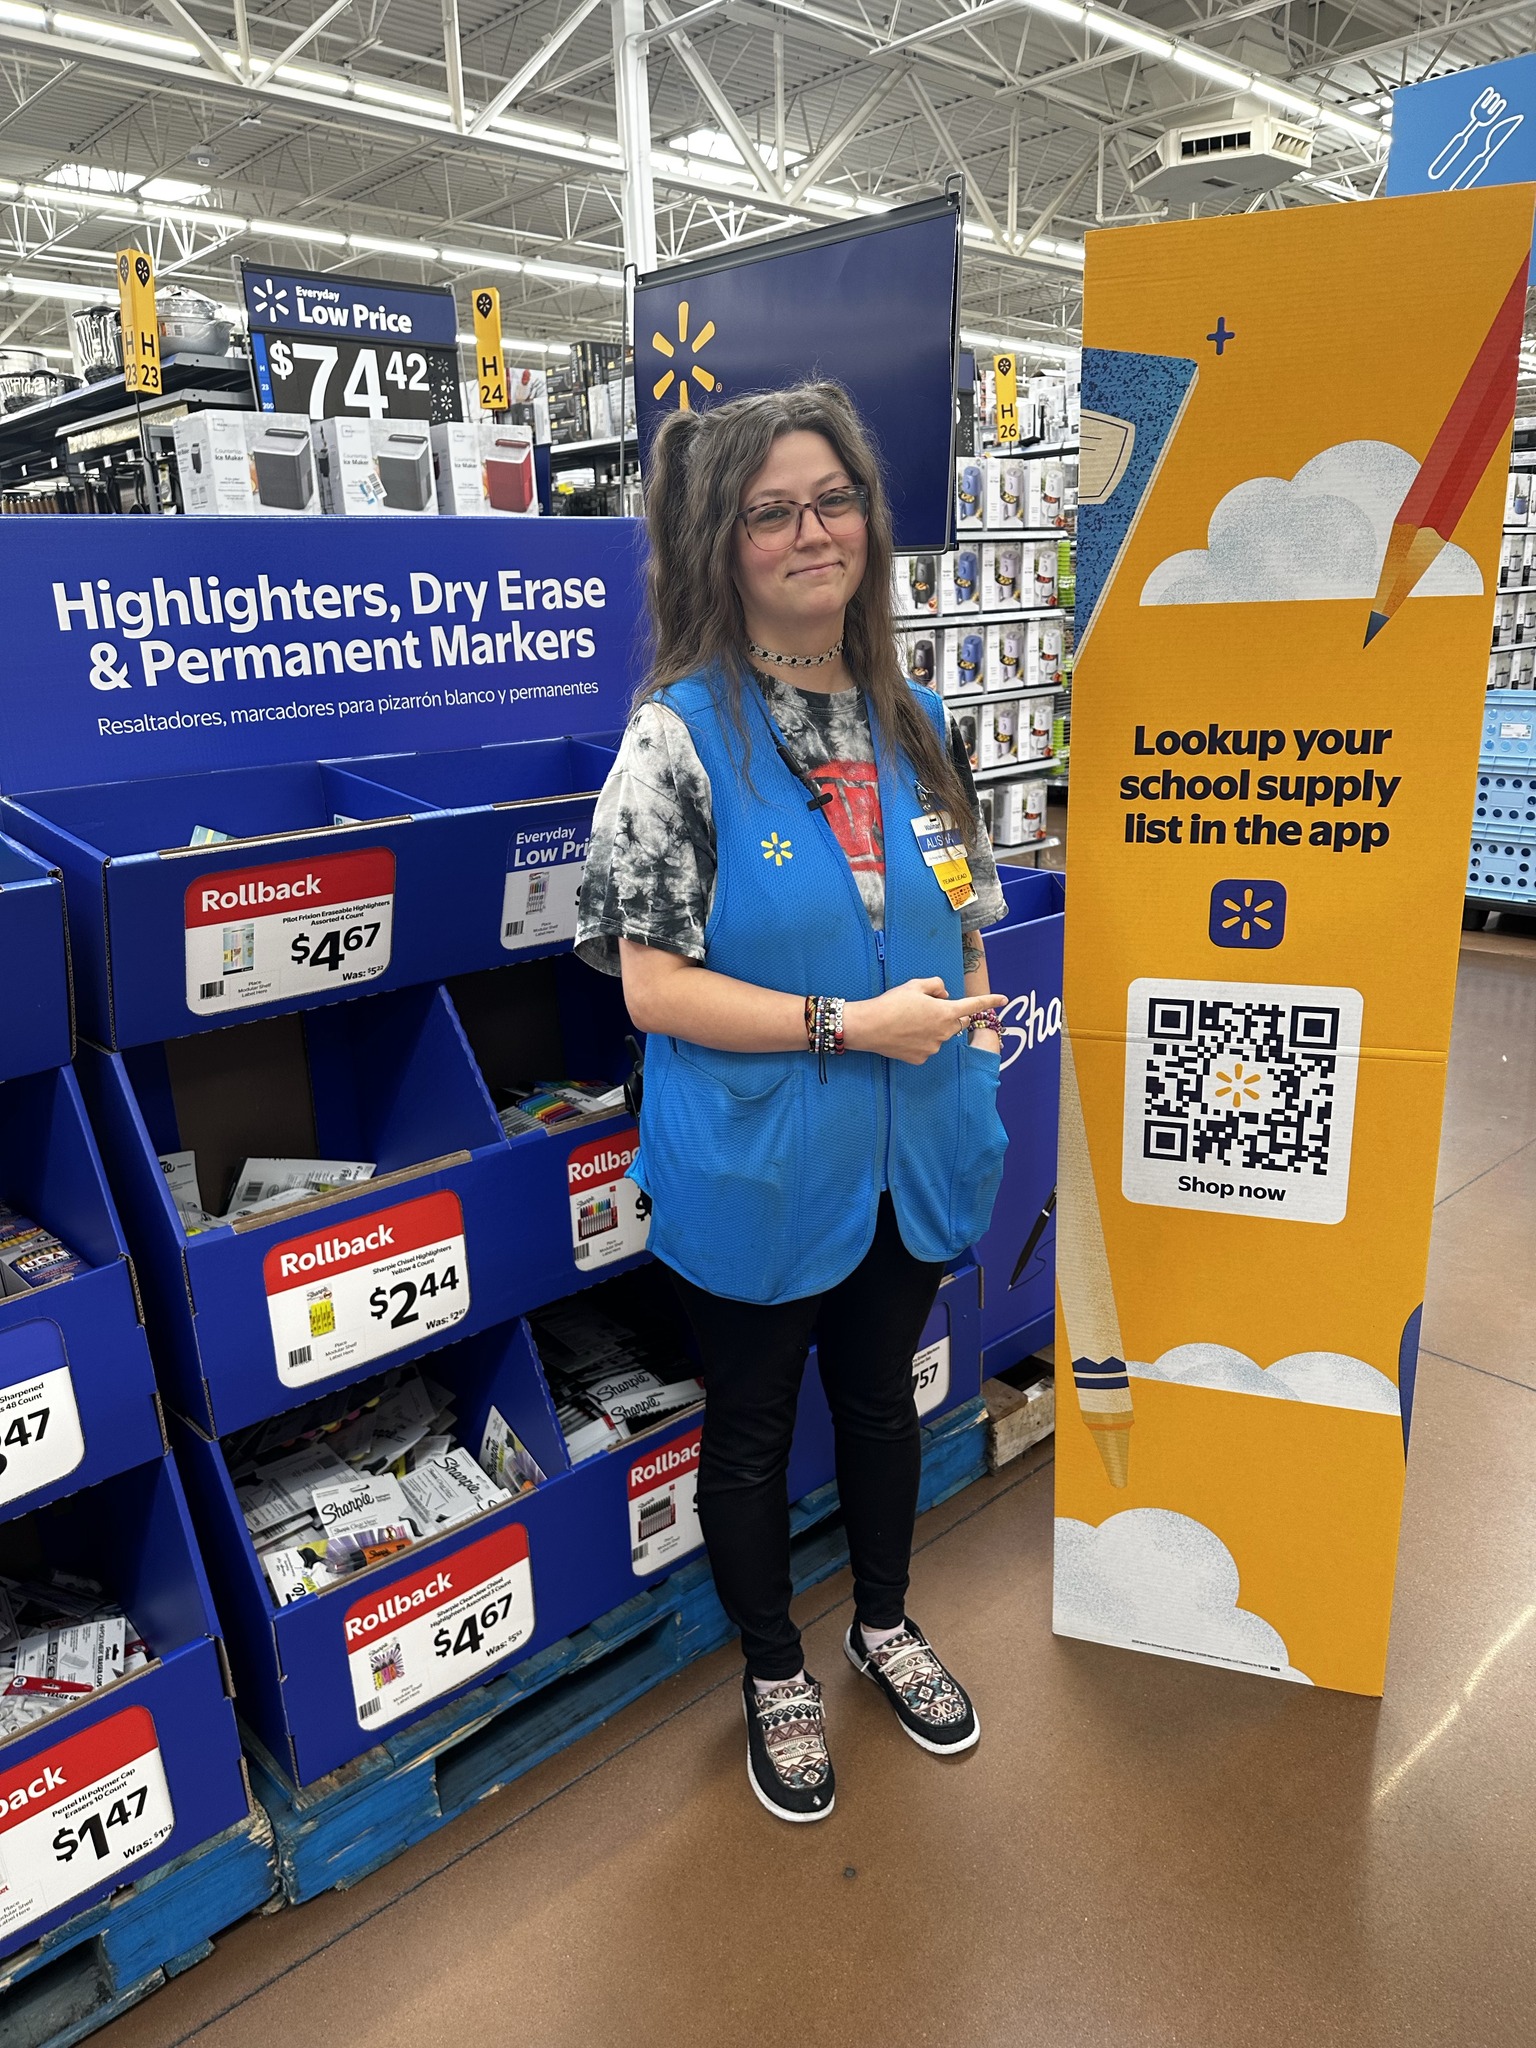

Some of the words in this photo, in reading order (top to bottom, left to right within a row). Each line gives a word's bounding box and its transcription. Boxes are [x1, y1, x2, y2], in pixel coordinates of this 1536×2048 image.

[295, 285, 340, 303] Everyday
[297, 297, 349, 327] Low
[352, 303, 413, 334] Price
[141, 331, 155, 358] H
[141, 364, 159, 388] 23
[481, 355, 498, 377] H
[481, 385, 504, 404] 24
[1001, 403, 1014, 419] H
[1000, 423, 1017, 438] 26
[52, 574, 401, 639] Highlighters,
[409, 571, 489, 622] Dry
[497, 569, 606, 611] Erase
[89, 641, 133, 691] &
[140, 630, 422, 687] Permanent
[429, 620, 596, 667] Markers
[97, 710, 227, 736] Resaltadores,
[230, 700, 335, 724] marcadores
[338, 699, 375, 718] para
[377, 691, 443, 715] pizarrón
[444, 689, 495, 706] blanco
[498, 689, 507, 704] y
[509, 680, 599, 704] permanentes
[1134, 723, 1286, 761] Lookup
[1293, 728, 1393, 761] your
[1119, 769, 1250, 800] school
[1256, 769, 1402, 807] supply
[516, 826, 576, 845] Everyday
[1124, 813, 1183, 844] list
[1190, 813, 1226, 844] in
[1234, 814, 1302, 845] the
[1308, 820, 1390, 853] app
[513, 847, 558, 867] Low
[562, 837, 591, 860] Pri
[201, 873, 322, 913] Rollback
[942, 875, 955, 885] TEAM
[954, 872, 967, 882] LEAD
[282, 916, 298, 924] Pilot
[298, 912, 321, 921] Frixion
[321, 907, 353, 917] Eraseable
[352, 900, 390, 912] Highlighters
[311, 917, 340, 926] Assorted
[345, 912, 364, 920] Count
[342, 970, 366, 981] Was:
[1178, 1175, 1234, 1199] Shop
[1238, 1182, 1286, 1201] now
[280, 1223, 395, 1278] Rollback
[372, 1263, 397, 1275] Sharpie
[396, 1255, 415, 1266] Chisel
[415, 1245, 452, 1260] Highlighters
[391, 1266, 411, 1276] Yellow
[417, 1258, 435, 1267] Count
[425, 1316, 449, 1330] Was:
[596, 1372, 650, 1401] Sharpie
[6, 1401, 17, 1411] 48
[17, 1392, 42, 1406] Count
[610, 1396, 660, 1425] Sharpie
[433, 1456, 479, 1495] Sharpie
[630, 1441, 701, 1487] Rollbac
[321, 1491, 375, 1526] Sharpie
[345, 1571, 454, 1641] Rollback
[430, 1605, 466, 1628] Highlighters
[495, 1579, 512, 1592] Count
[436, 1602, 459, 1617] Sharpie
[485, 1640, 508, 1657] Was:
[51, 1800, 78, 1818] Pentel
[79, 1793, 87, 1803] Hi
[87, 1776, 120, 1798] Polymer
[120, 1768, 136, 1780] Cap
[65, 1800, 94, 1819] Erasers
[94, 1794, 104, 1803] 10
[104, 1780, 128, 1797] Count
[122, 1837, 153, 1859] Was:
